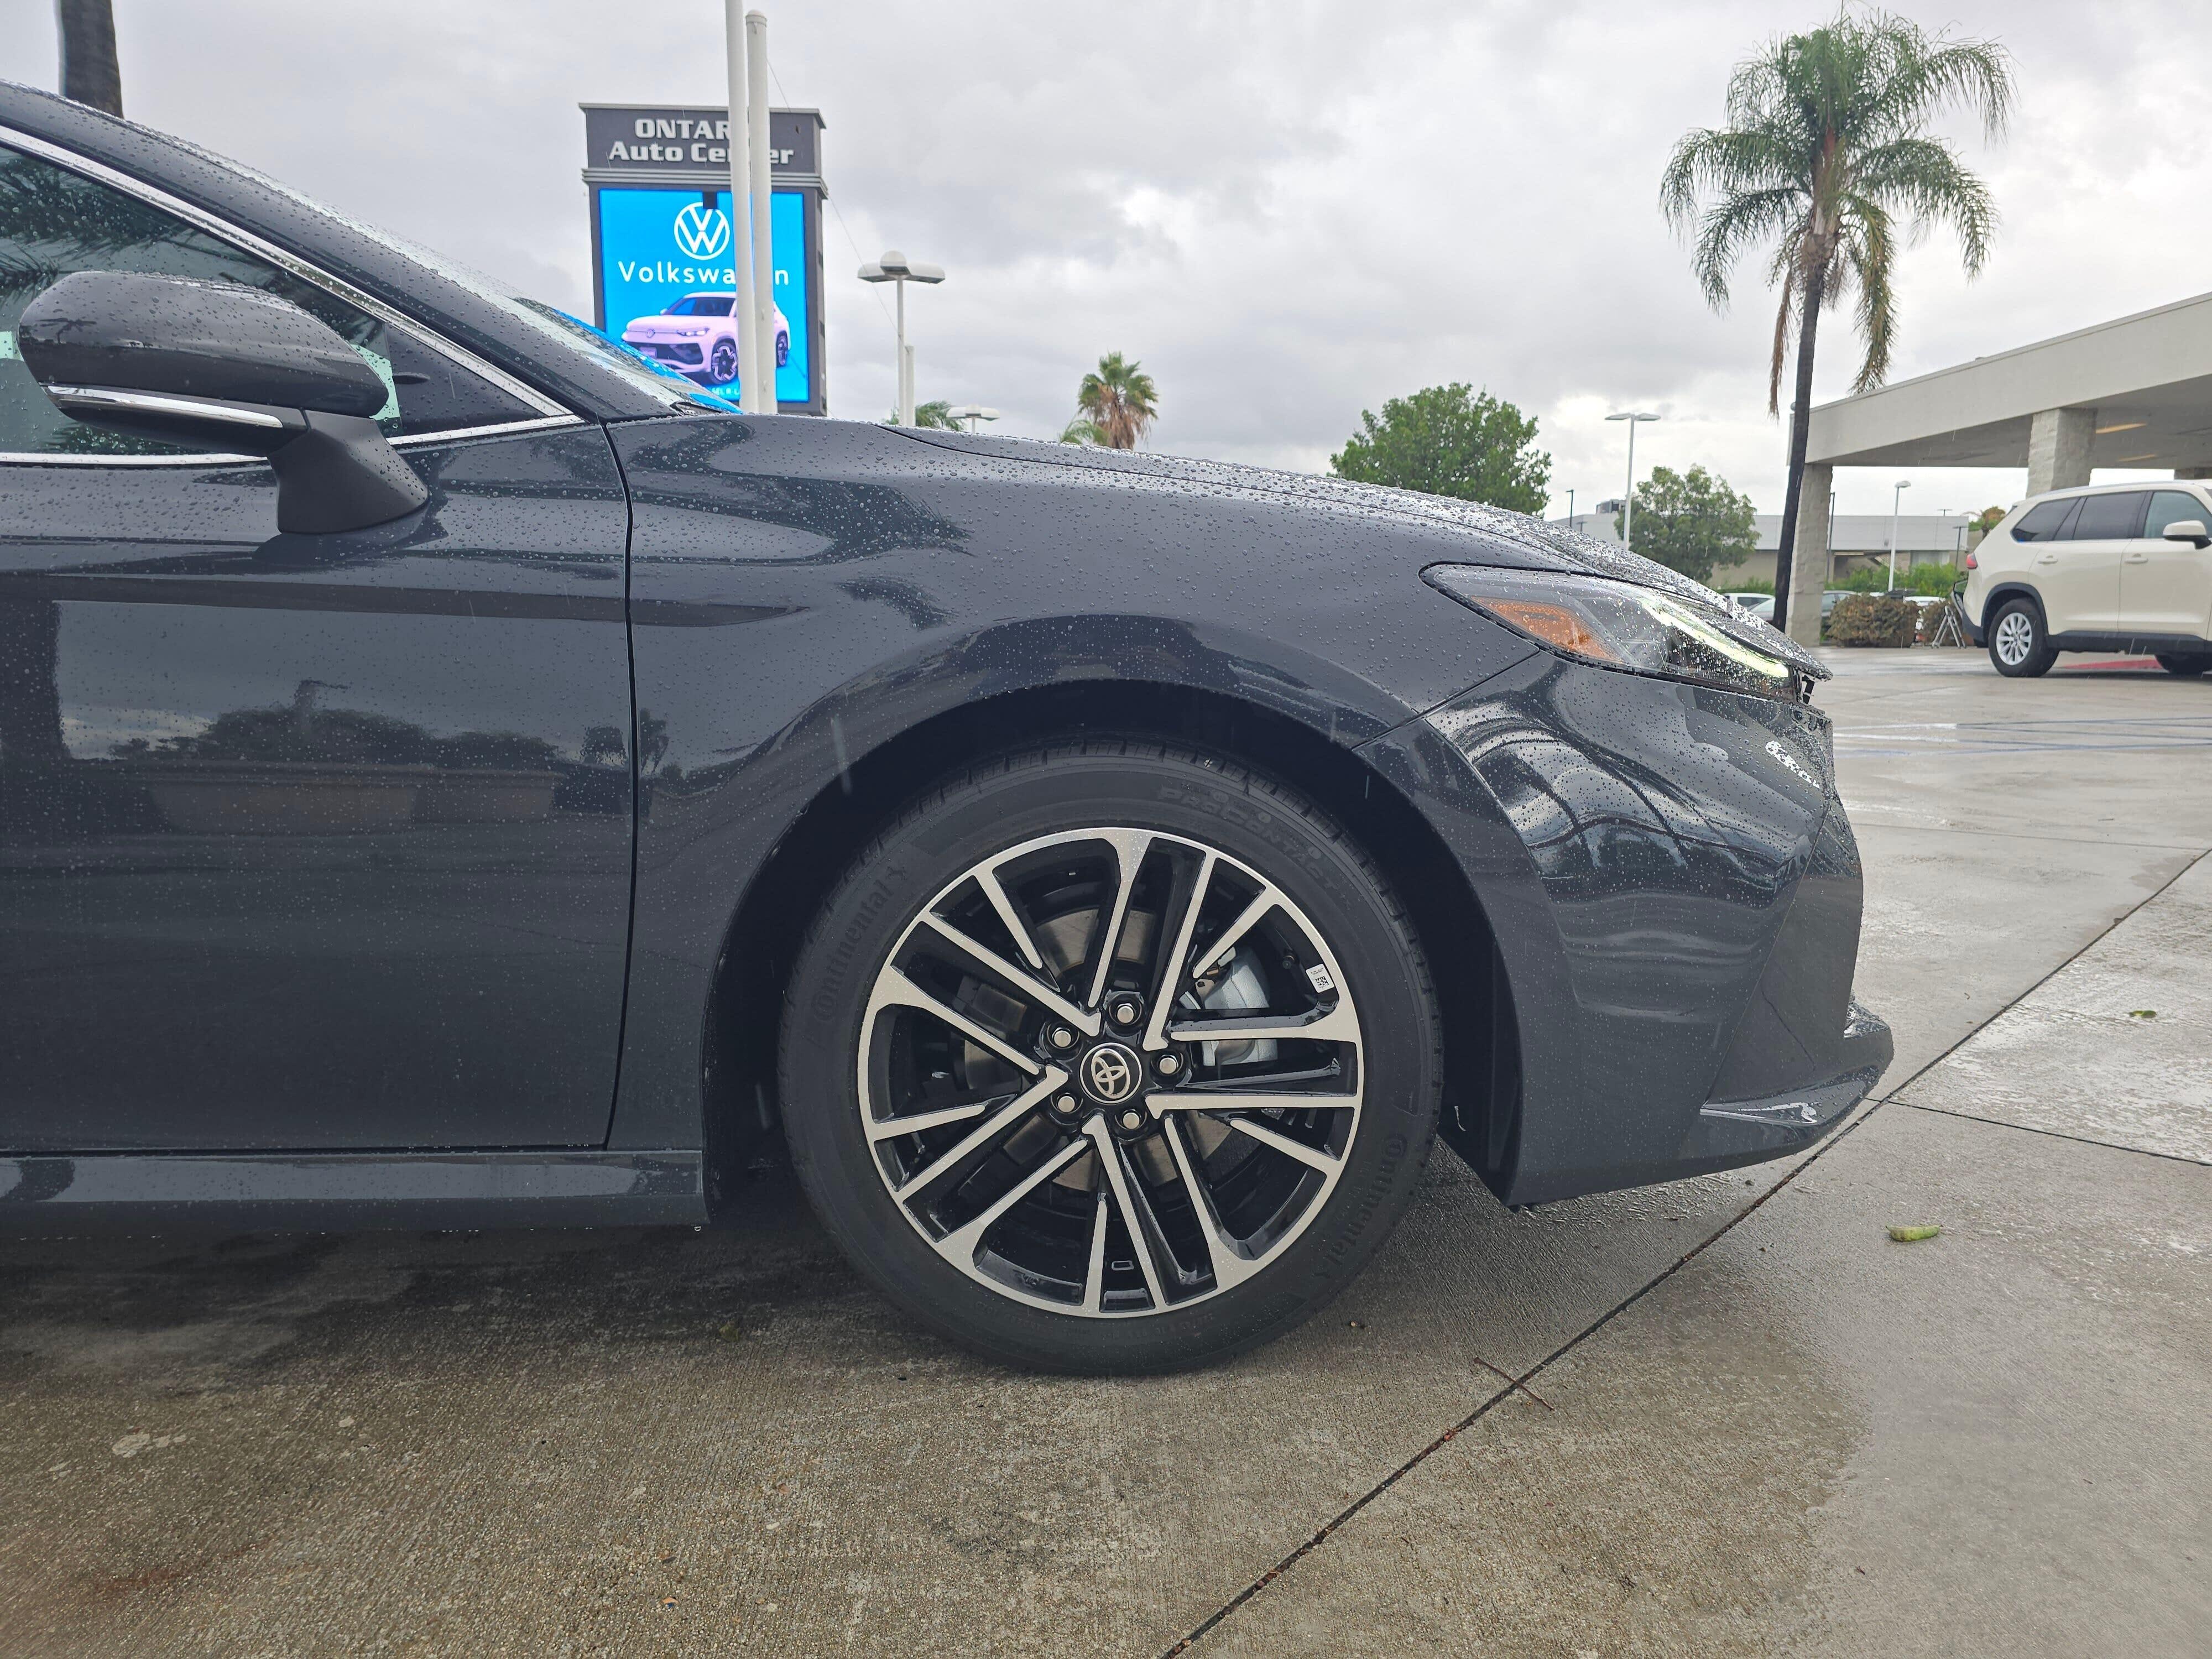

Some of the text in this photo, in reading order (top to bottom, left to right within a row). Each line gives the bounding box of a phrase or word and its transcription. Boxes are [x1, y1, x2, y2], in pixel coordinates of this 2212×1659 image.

[635, 118, 730, 139] ONTAR
[609, 140, 794, 164] Auto Ceer
[617, 260, 789, 286] Volkswan
